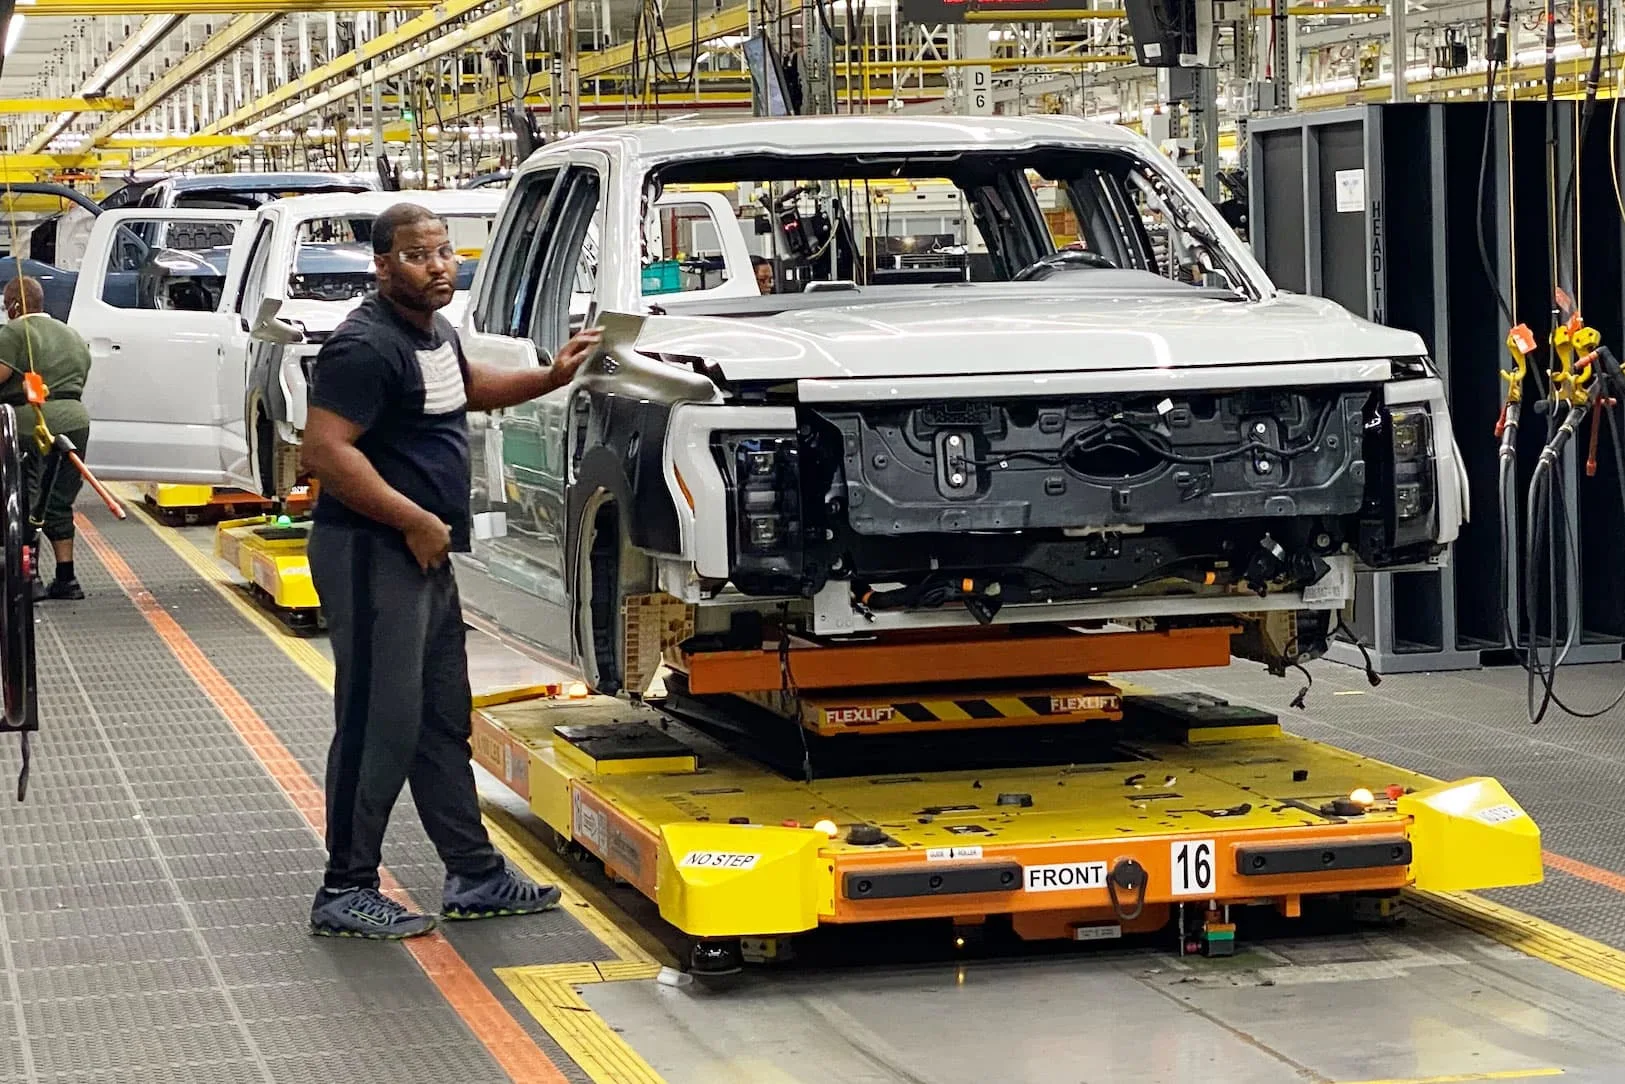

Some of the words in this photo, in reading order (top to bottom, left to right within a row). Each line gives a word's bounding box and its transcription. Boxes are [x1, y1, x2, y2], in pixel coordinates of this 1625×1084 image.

[975, 71, 984, 86] D
[1050, 694, 1120, 713] FLEXLIFT
[826, 706, 895, 724] FLEXLIFT
[685, 852, 712, 865] NO
[711, 854, 755, 867] STEP
[1177, 843, 1212, 889] 16
[1029, 865, 1104, 888] FRONT
